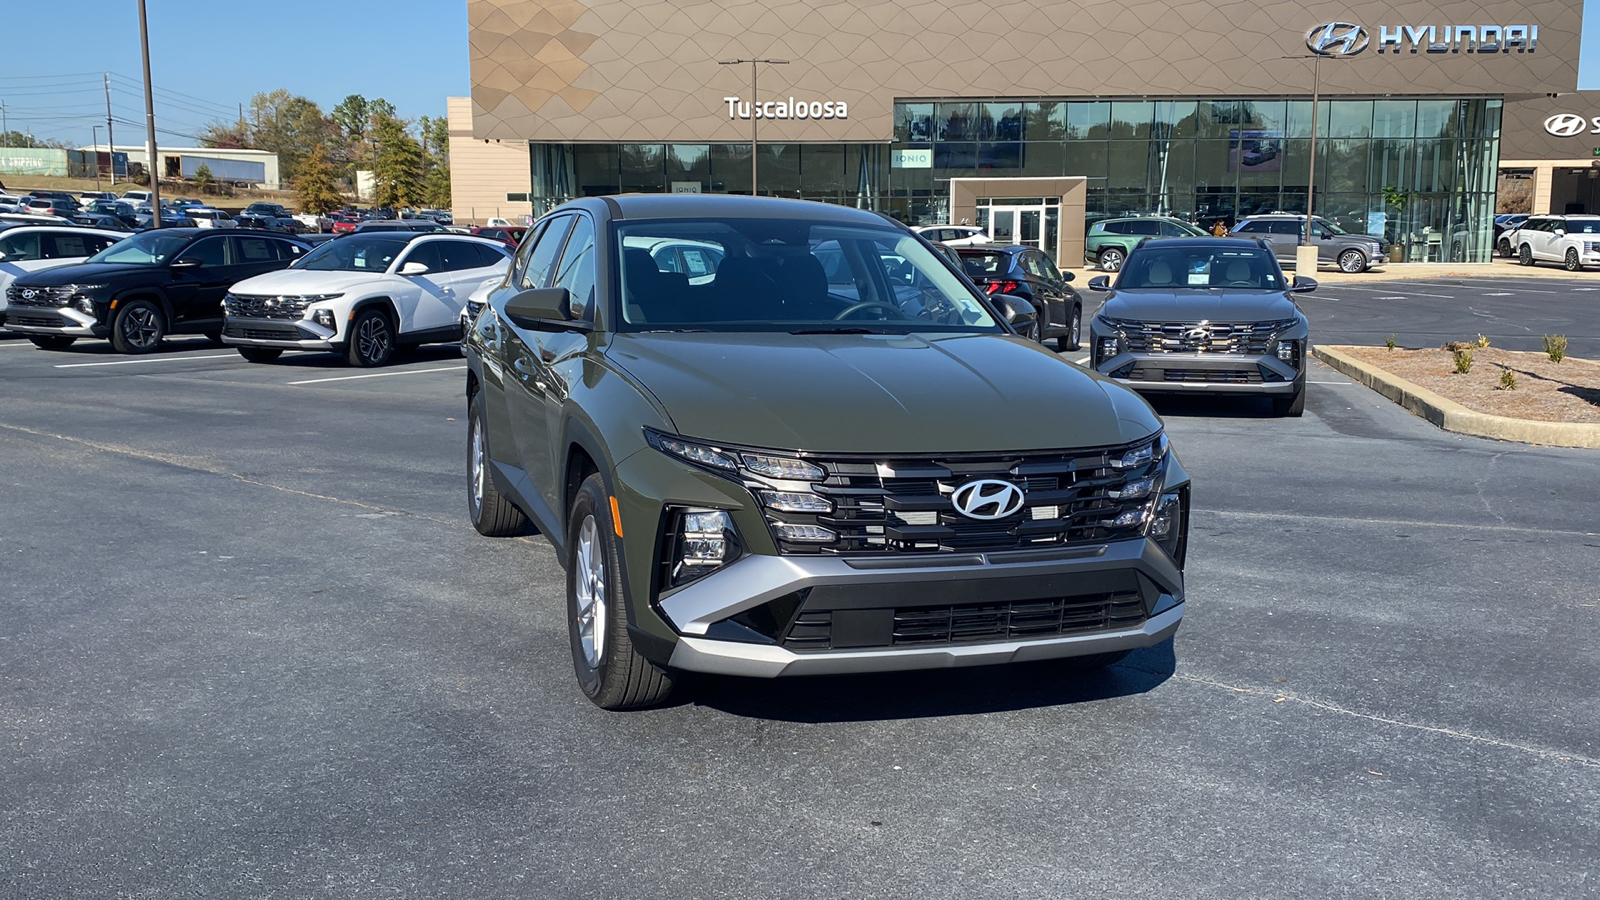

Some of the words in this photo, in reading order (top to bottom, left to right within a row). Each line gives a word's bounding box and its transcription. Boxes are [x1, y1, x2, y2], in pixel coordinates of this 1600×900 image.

[1379, 25, 1538, 53] HYUNDAI
[724, 96, 848, 119] Tuscaloosa
[895, 155, 927, 163] IONIQ
